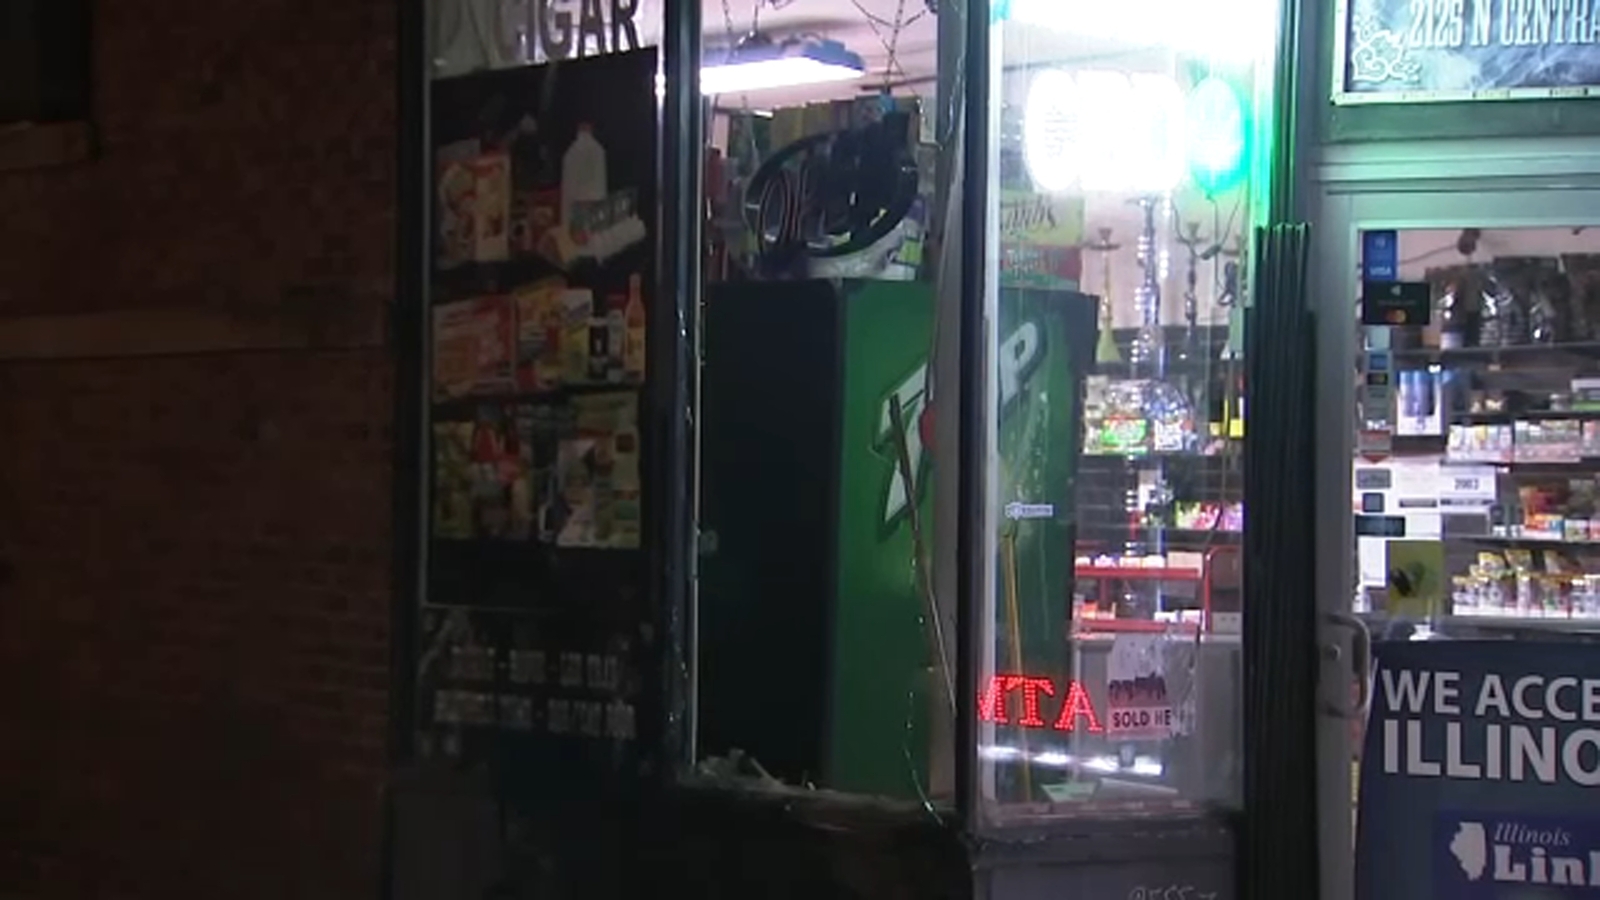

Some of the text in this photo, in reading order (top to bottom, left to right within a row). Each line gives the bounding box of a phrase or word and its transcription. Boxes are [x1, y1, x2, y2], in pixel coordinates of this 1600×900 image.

[1410, 0, 1464, 47] 2125
[1470, 0, 1492, 47] N
[1113, 709, 1150, 728] SOLD
[1382, 669, 1600, 722] WE ACCE
[1384, 719, 1600, 787] ILLINO
[1494, 822, 1571, 847] Illinois
